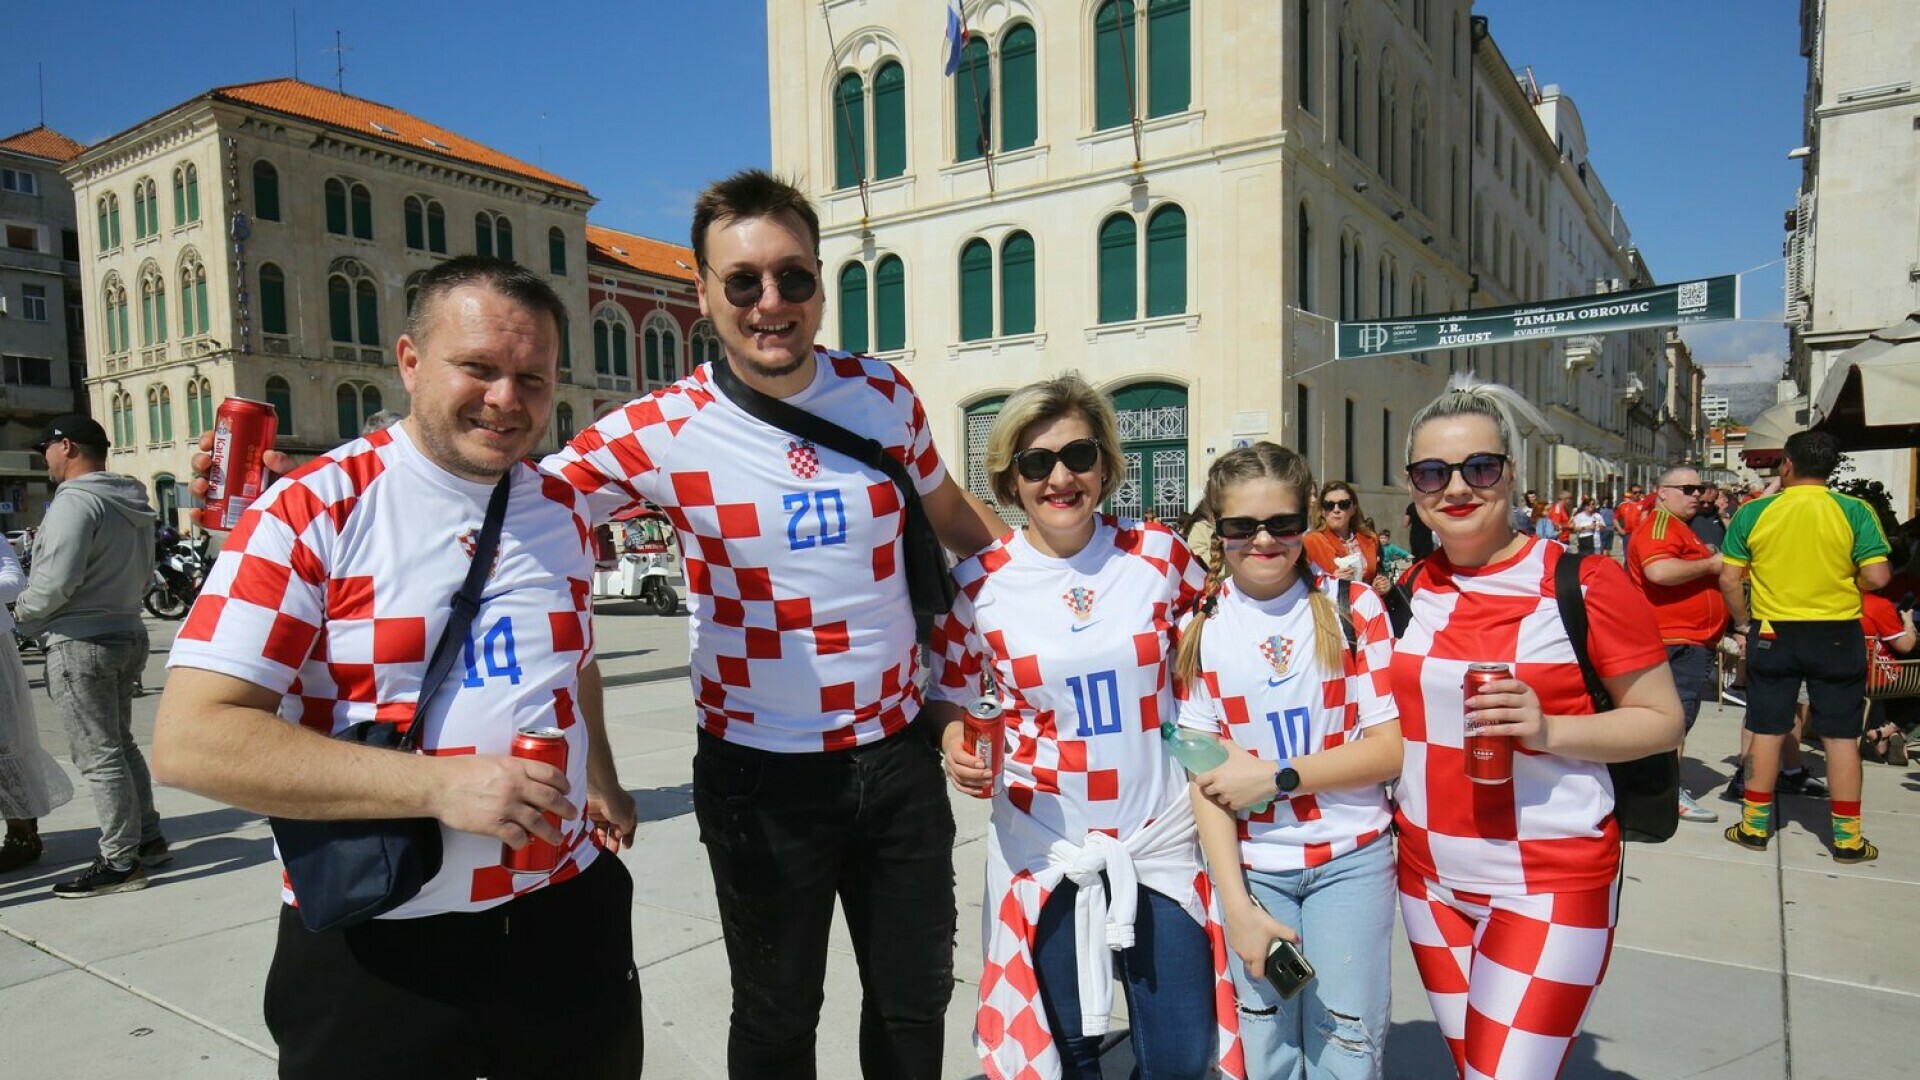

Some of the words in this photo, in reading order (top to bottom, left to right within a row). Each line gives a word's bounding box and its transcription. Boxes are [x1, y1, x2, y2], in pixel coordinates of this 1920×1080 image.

[1438, 324, 1448, 335] J.
[1450, 323, 1462, 334] R.
[1513, 310, 1576, 327] TAMARA
[1578, 302, 1650, 319] OBROVAC
[1513, 326, 1558, 338] KVARTET
[1438, 331, 1492, 346] AUGUST
[782, 488, 846, 551] 20
[462, 616, 523, 688] 14
[1065, 669, 1122, 737] 10
[1266, 706, 1311, 760] 10
